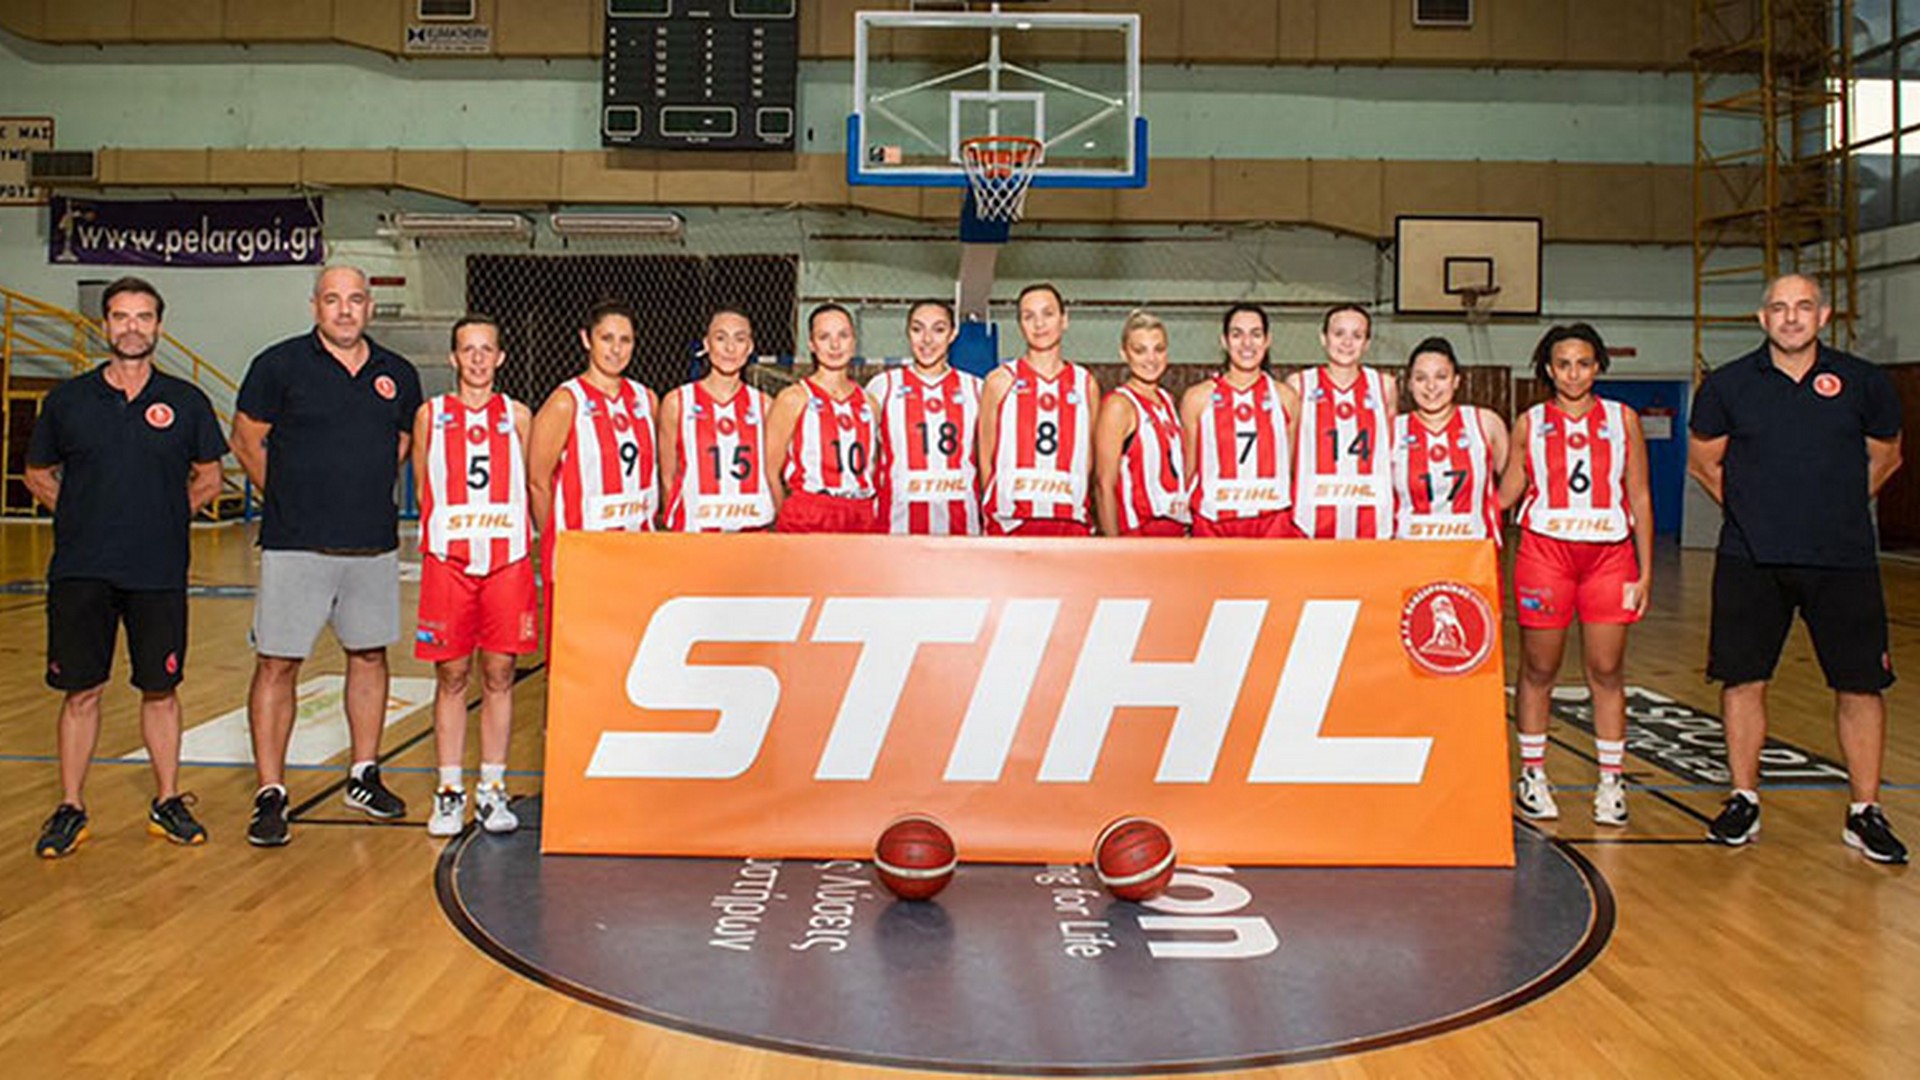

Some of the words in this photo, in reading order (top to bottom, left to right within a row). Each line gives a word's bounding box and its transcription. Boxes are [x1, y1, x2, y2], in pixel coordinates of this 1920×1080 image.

[77, 215, 319, 262] www.pelargoi.gr
[917, 421, 957, 455] 18
[1035, 421, 1057, 456] 8
[1237, 432, 1257, 465] 7
[1327, 428, 1369, 462] 14
[466, 455, 491, 490] 5
[619, 441, 639, 477] 9
[708, 446, 752, 480] 15
[831, 440, 866, 477] 10
[907, 478, 968, 493] STIHL
[1013, 478, 1074, 495] STIHL
[1313, 483, 1377, 498] STIHL
[1419, 470, 1467, 502] 17
[1568, 459, 1591, 494] 6
[1216, 487, 1280, 501] STIHL
[447, 514, 515, 530] STIHL
[694, 504, 761, 518] STIHL
[1546, 516, 1614, 532] STIHL
[1409, 522, 1473, 536] STIHL
[584, 597, 1434, 783] STIHL
[1052, 888, 1100, 916] for
[1058, 920, 1117, 958] Life
